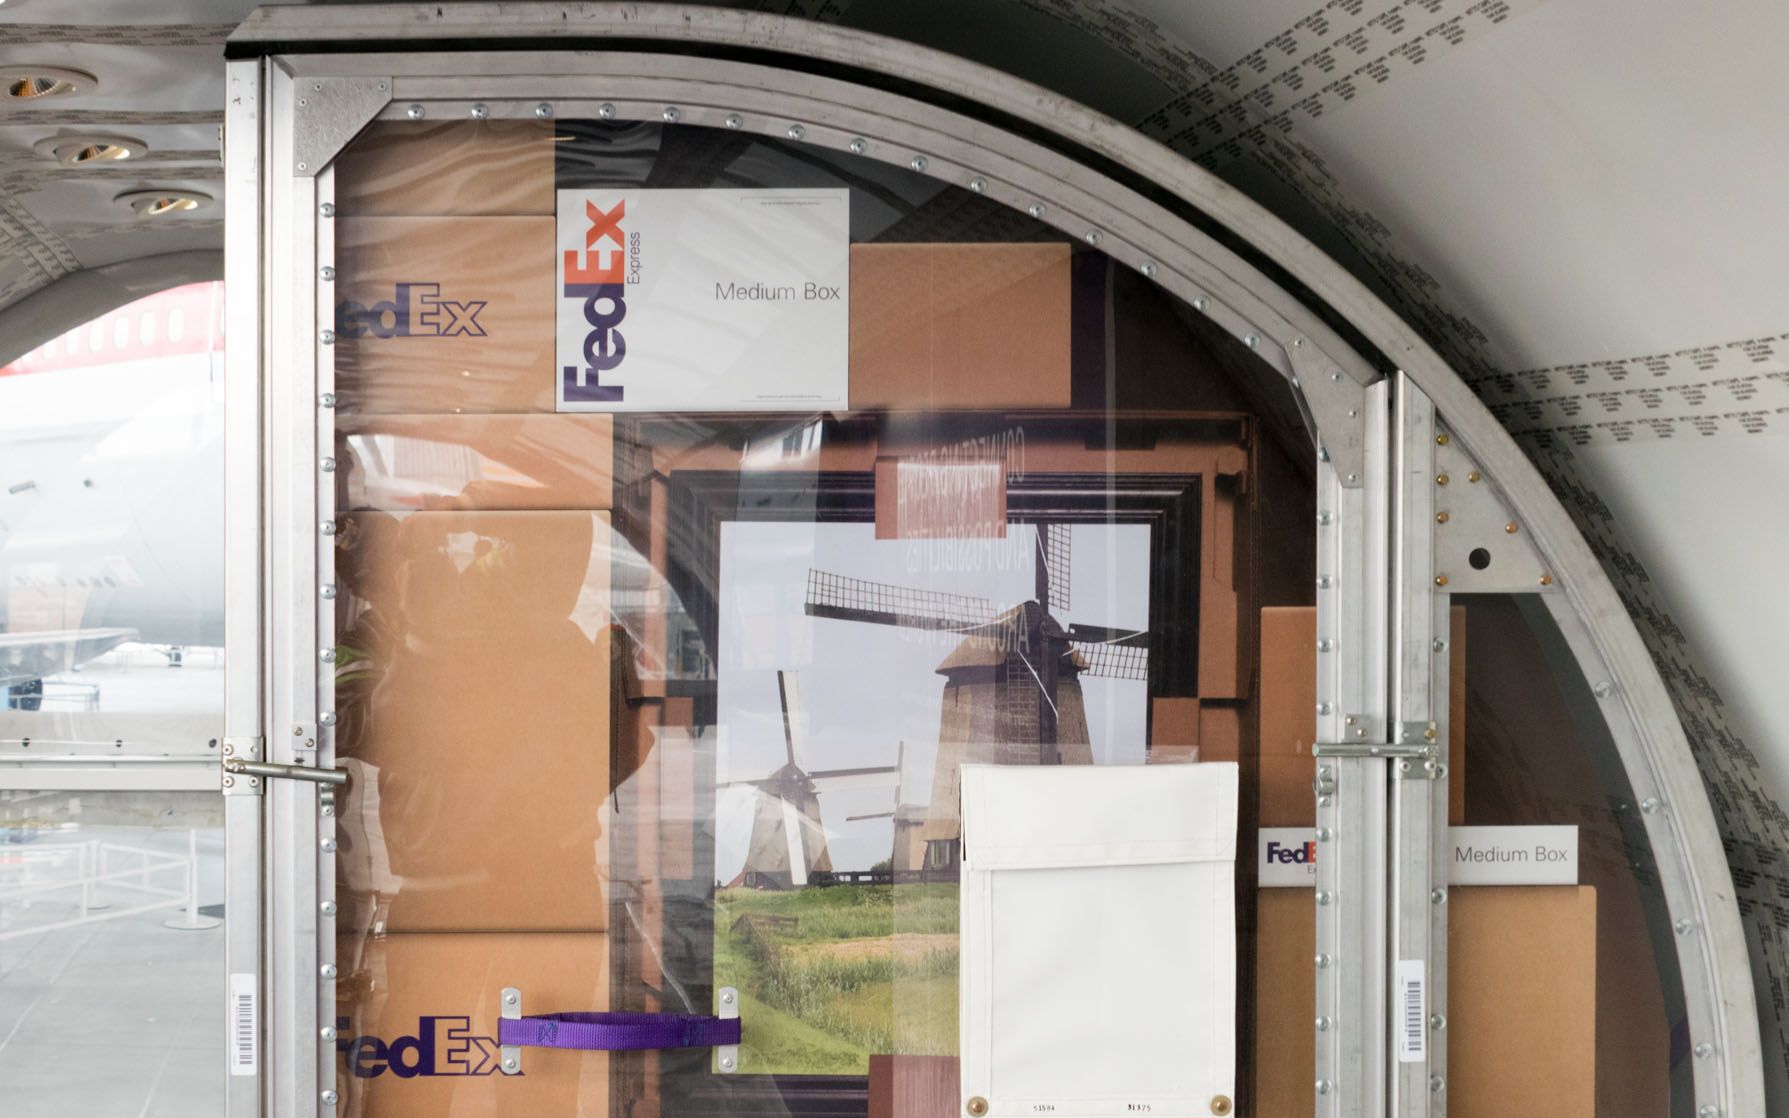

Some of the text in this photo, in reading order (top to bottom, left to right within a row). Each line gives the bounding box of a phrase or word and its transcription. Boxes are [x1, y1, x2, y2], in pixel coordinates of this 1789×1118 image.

[627, 231, 641, 285] Express
[336, 283, 488, 338] edEx
[563, 199, 627, 402] FedEx
[715, 282, 841, 301] Medium Box
[1266, 841, 1317, 864] FedE
[1455, 846, 1568, 862] Medium Box
